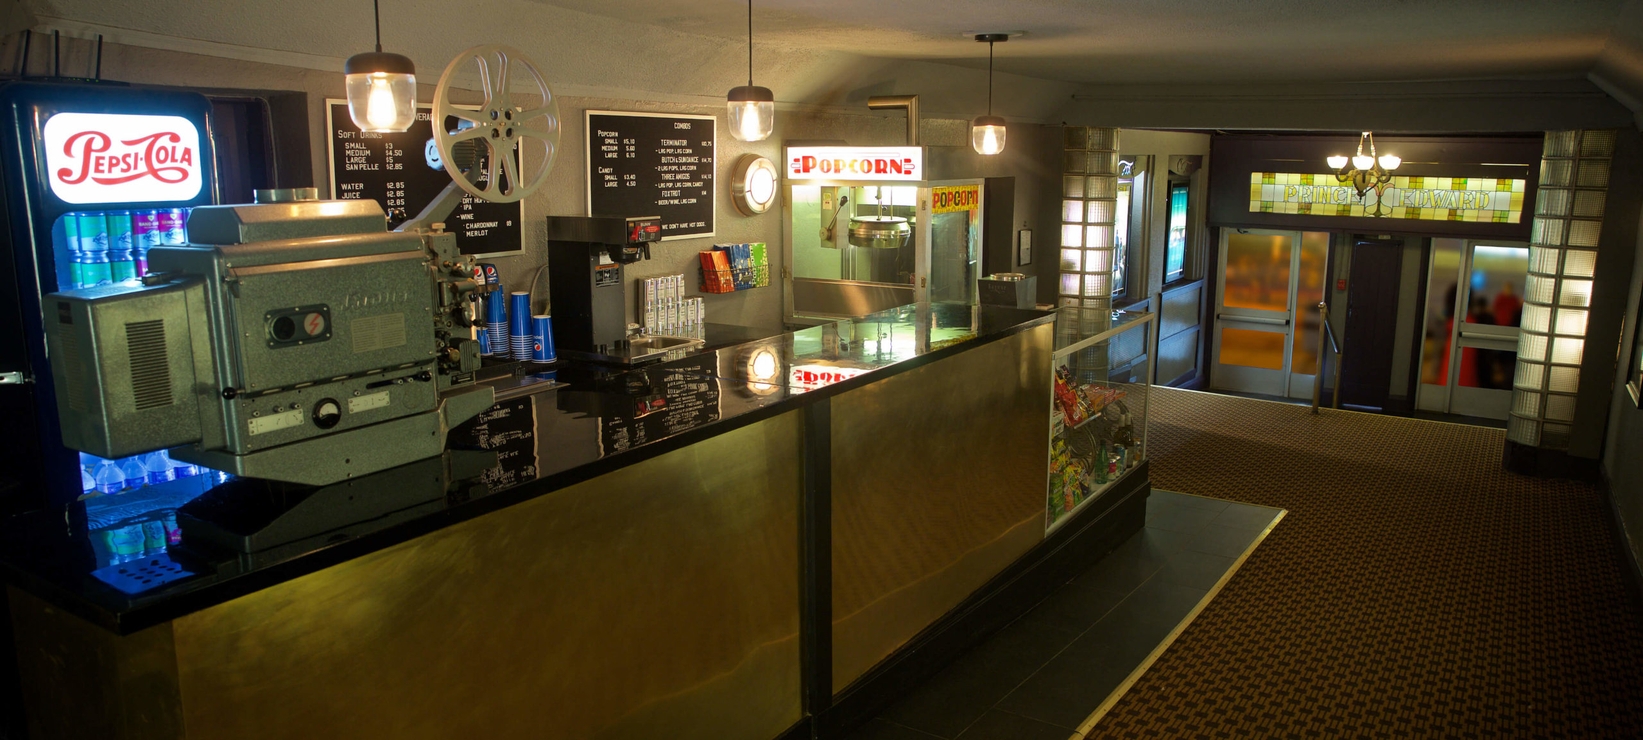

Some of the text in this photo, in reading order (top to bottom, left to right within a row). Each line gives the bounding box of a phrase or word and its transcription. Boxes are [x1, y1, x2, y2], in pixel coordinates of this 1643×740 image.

[338, 130, 356, 138] SOFT
[1284, 185, 1489, 209] PRINCE EDWARD
